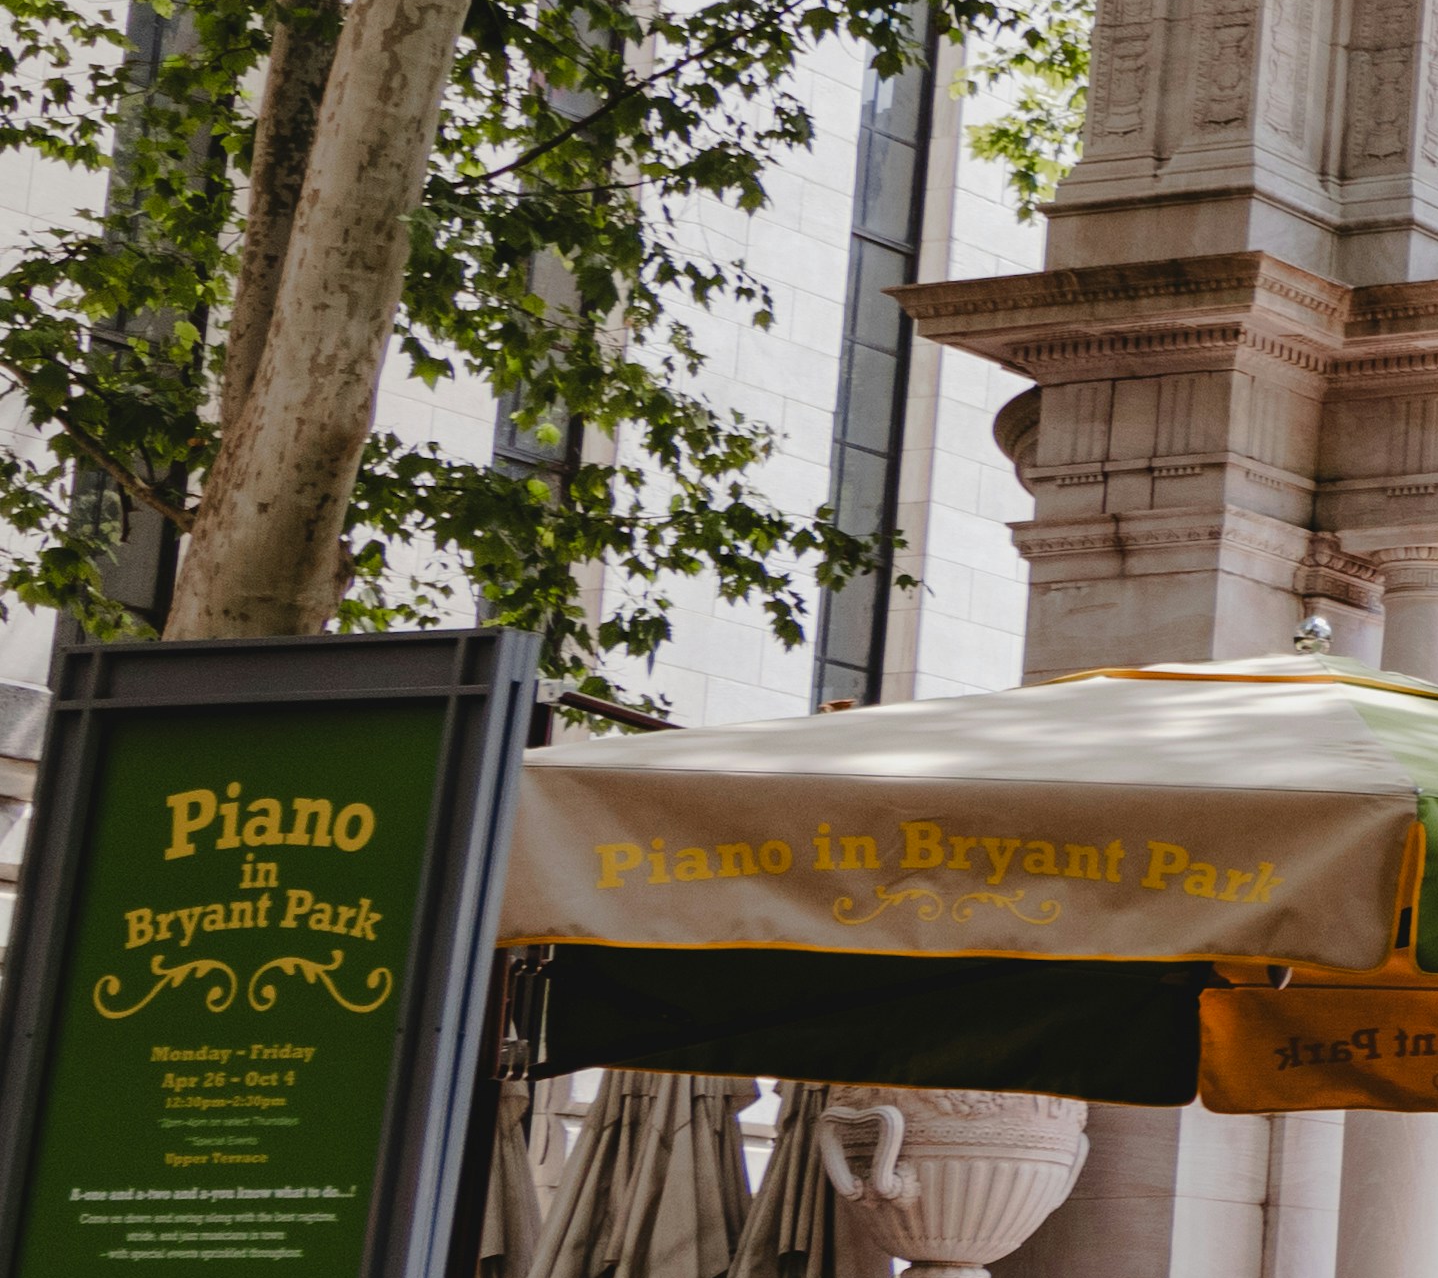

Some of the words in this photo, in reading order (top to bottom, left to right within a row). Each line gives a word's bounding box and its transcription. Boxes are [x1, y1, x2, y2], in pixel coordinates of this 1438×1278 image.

[164, 781, 375, 861] Piano
[239, 853, 279, 889] in
[596, 838, 791, 889] Piano
[813, 822, 879, 872] in
[900, 820, 1125, 884] Bryant
[1141, 840, 1284, 903] Park
[124, 893, 273, 949] Bryant
[280, 889, 383, 940] Park
[150, 1046, 231, 1064] Monday
[250, 1043, 317, 1063] Friday
[161, 1072, 199, 1091] Apr
[244, 1072, 278, 1088] Oct
[283, 1070, 296, 1086] 4
[165, 1152, 208, 1167] Upper
[213, 1151, 268, 1165] Terrace
